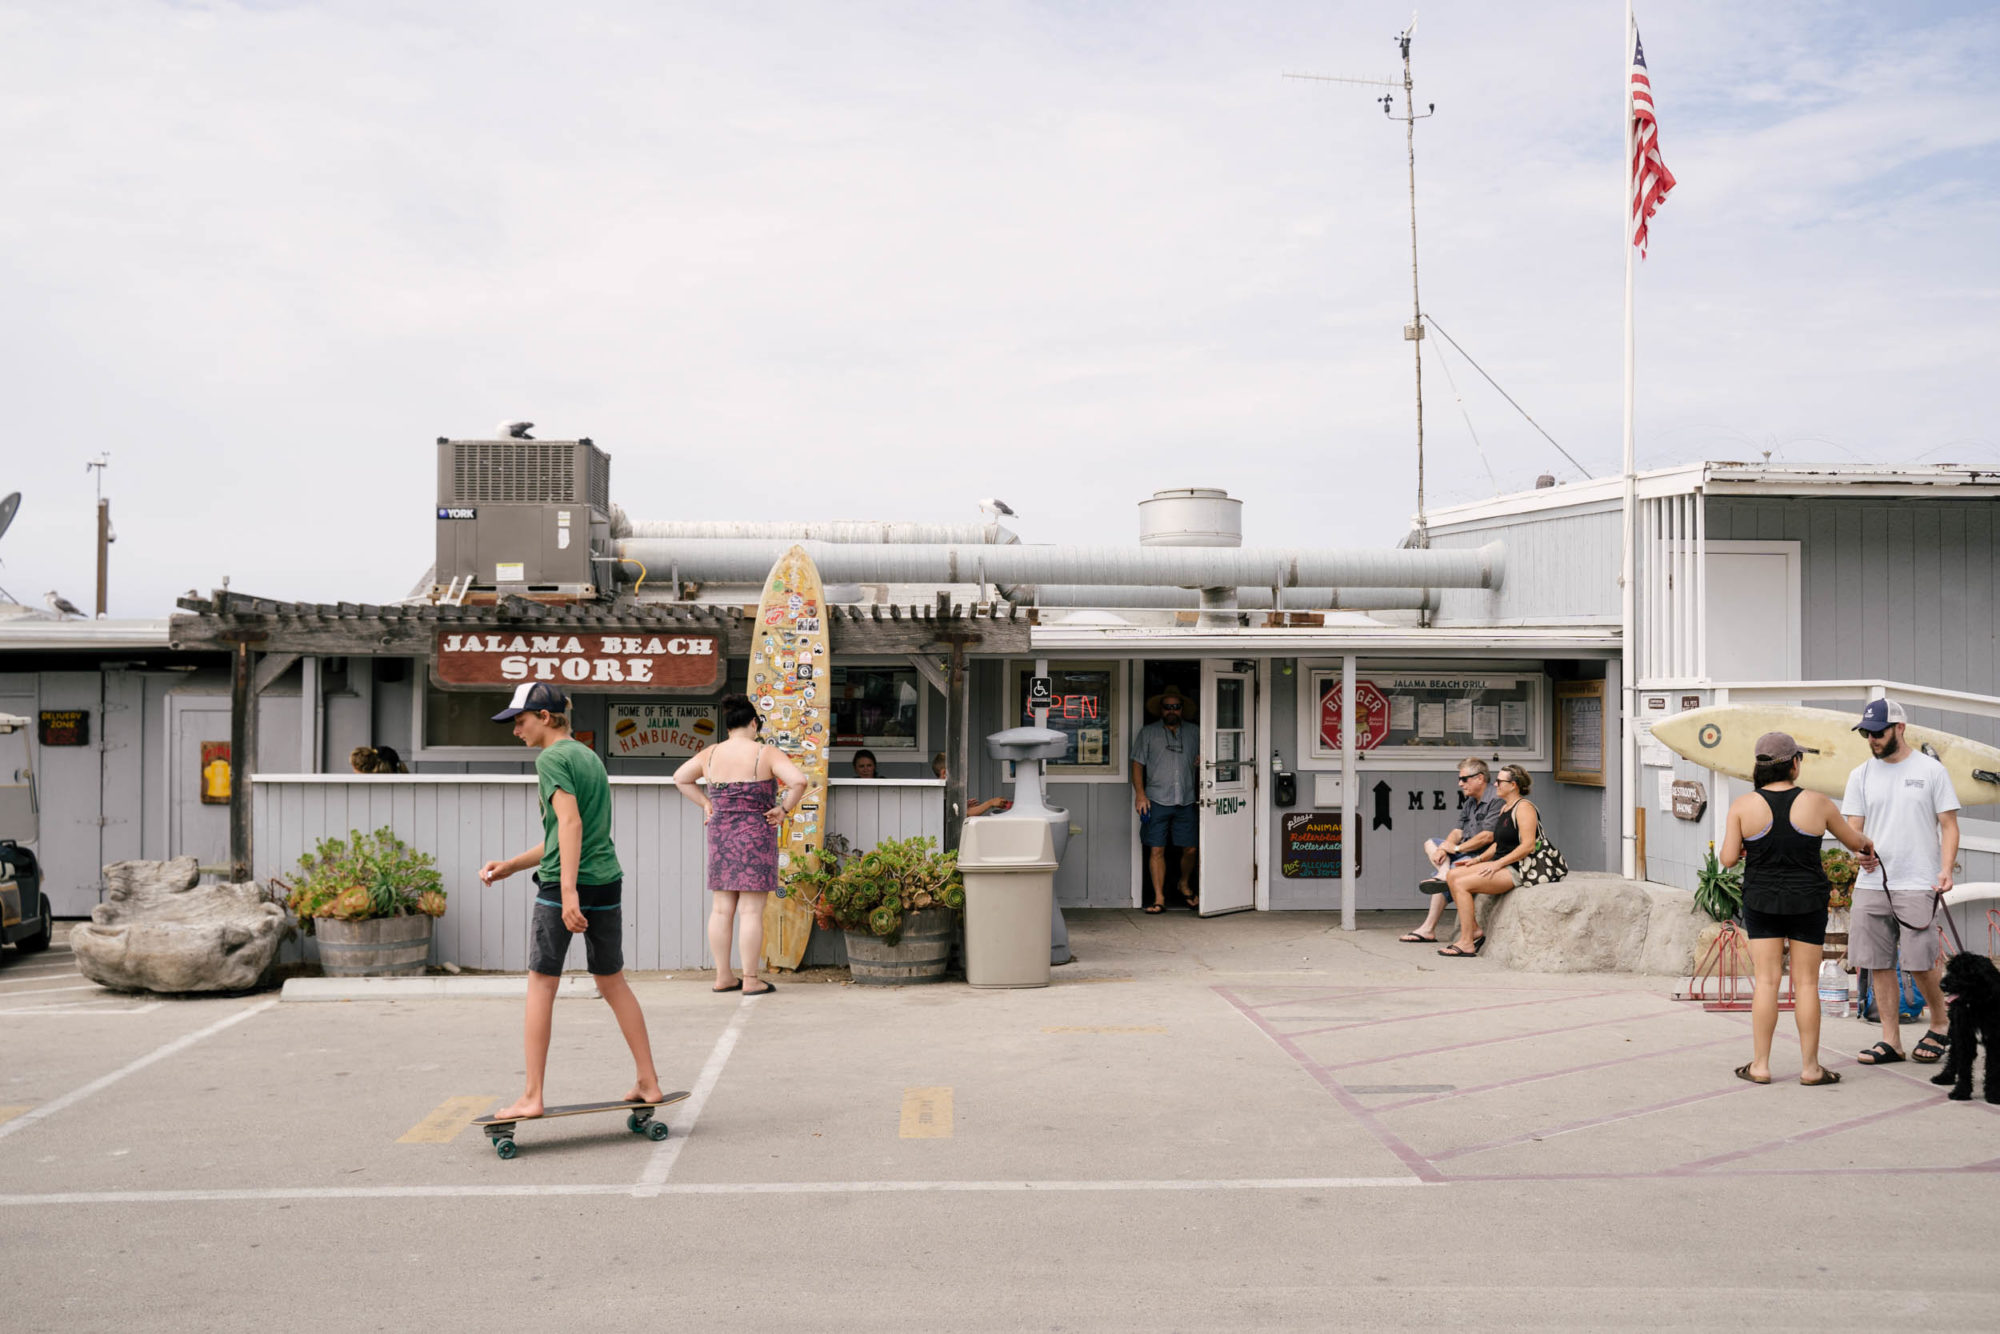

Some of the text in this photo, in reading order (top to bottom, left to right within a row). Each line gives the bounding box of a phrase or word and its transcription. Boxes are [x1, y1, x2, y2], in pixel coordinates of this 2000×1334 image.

[448, 509, 475, 519] YORK
[443, 635, 713, 655] JALAMA BEACH
[500, 655, 654, 682] STORE
[1393, 680, 1487, 689] JALAMA BEACH GRILL
[1326, 689, 1382, 713] BUGER
[41, 712, 82, 720] DELIVERY
[618, 706, 709, 717] HOME OF THE FAMOUS
[50, 721, 75, 729] ZONE
[646, 718, 680, 728] JALAMA
[619, 729, 705, 753] HAMBURGER
[1336, 732, 1372, 747] SOP
[1216, 797, 1238, 815] MENU
